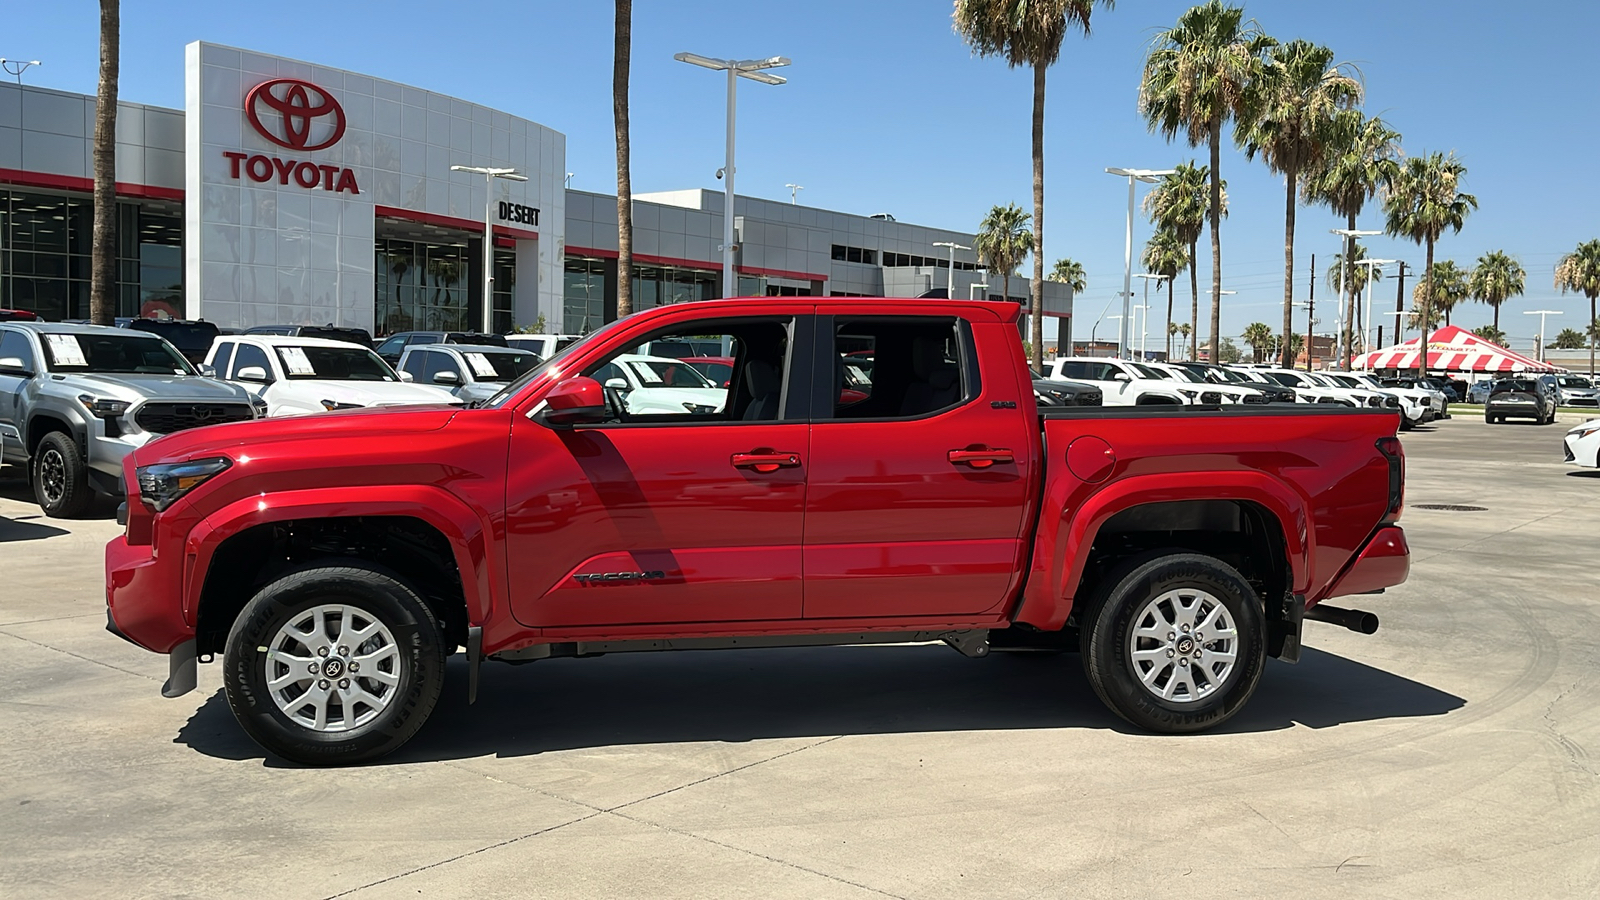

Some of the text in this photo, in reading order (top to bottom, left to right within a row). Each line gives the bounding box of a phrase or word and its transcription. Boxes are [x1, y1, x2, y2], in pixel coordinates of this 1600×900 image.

[222, 151, 360, 195] TOYOTA
[498, 200, 541, 227] DESERT
[573, 570, 665, 582] TACOMA
